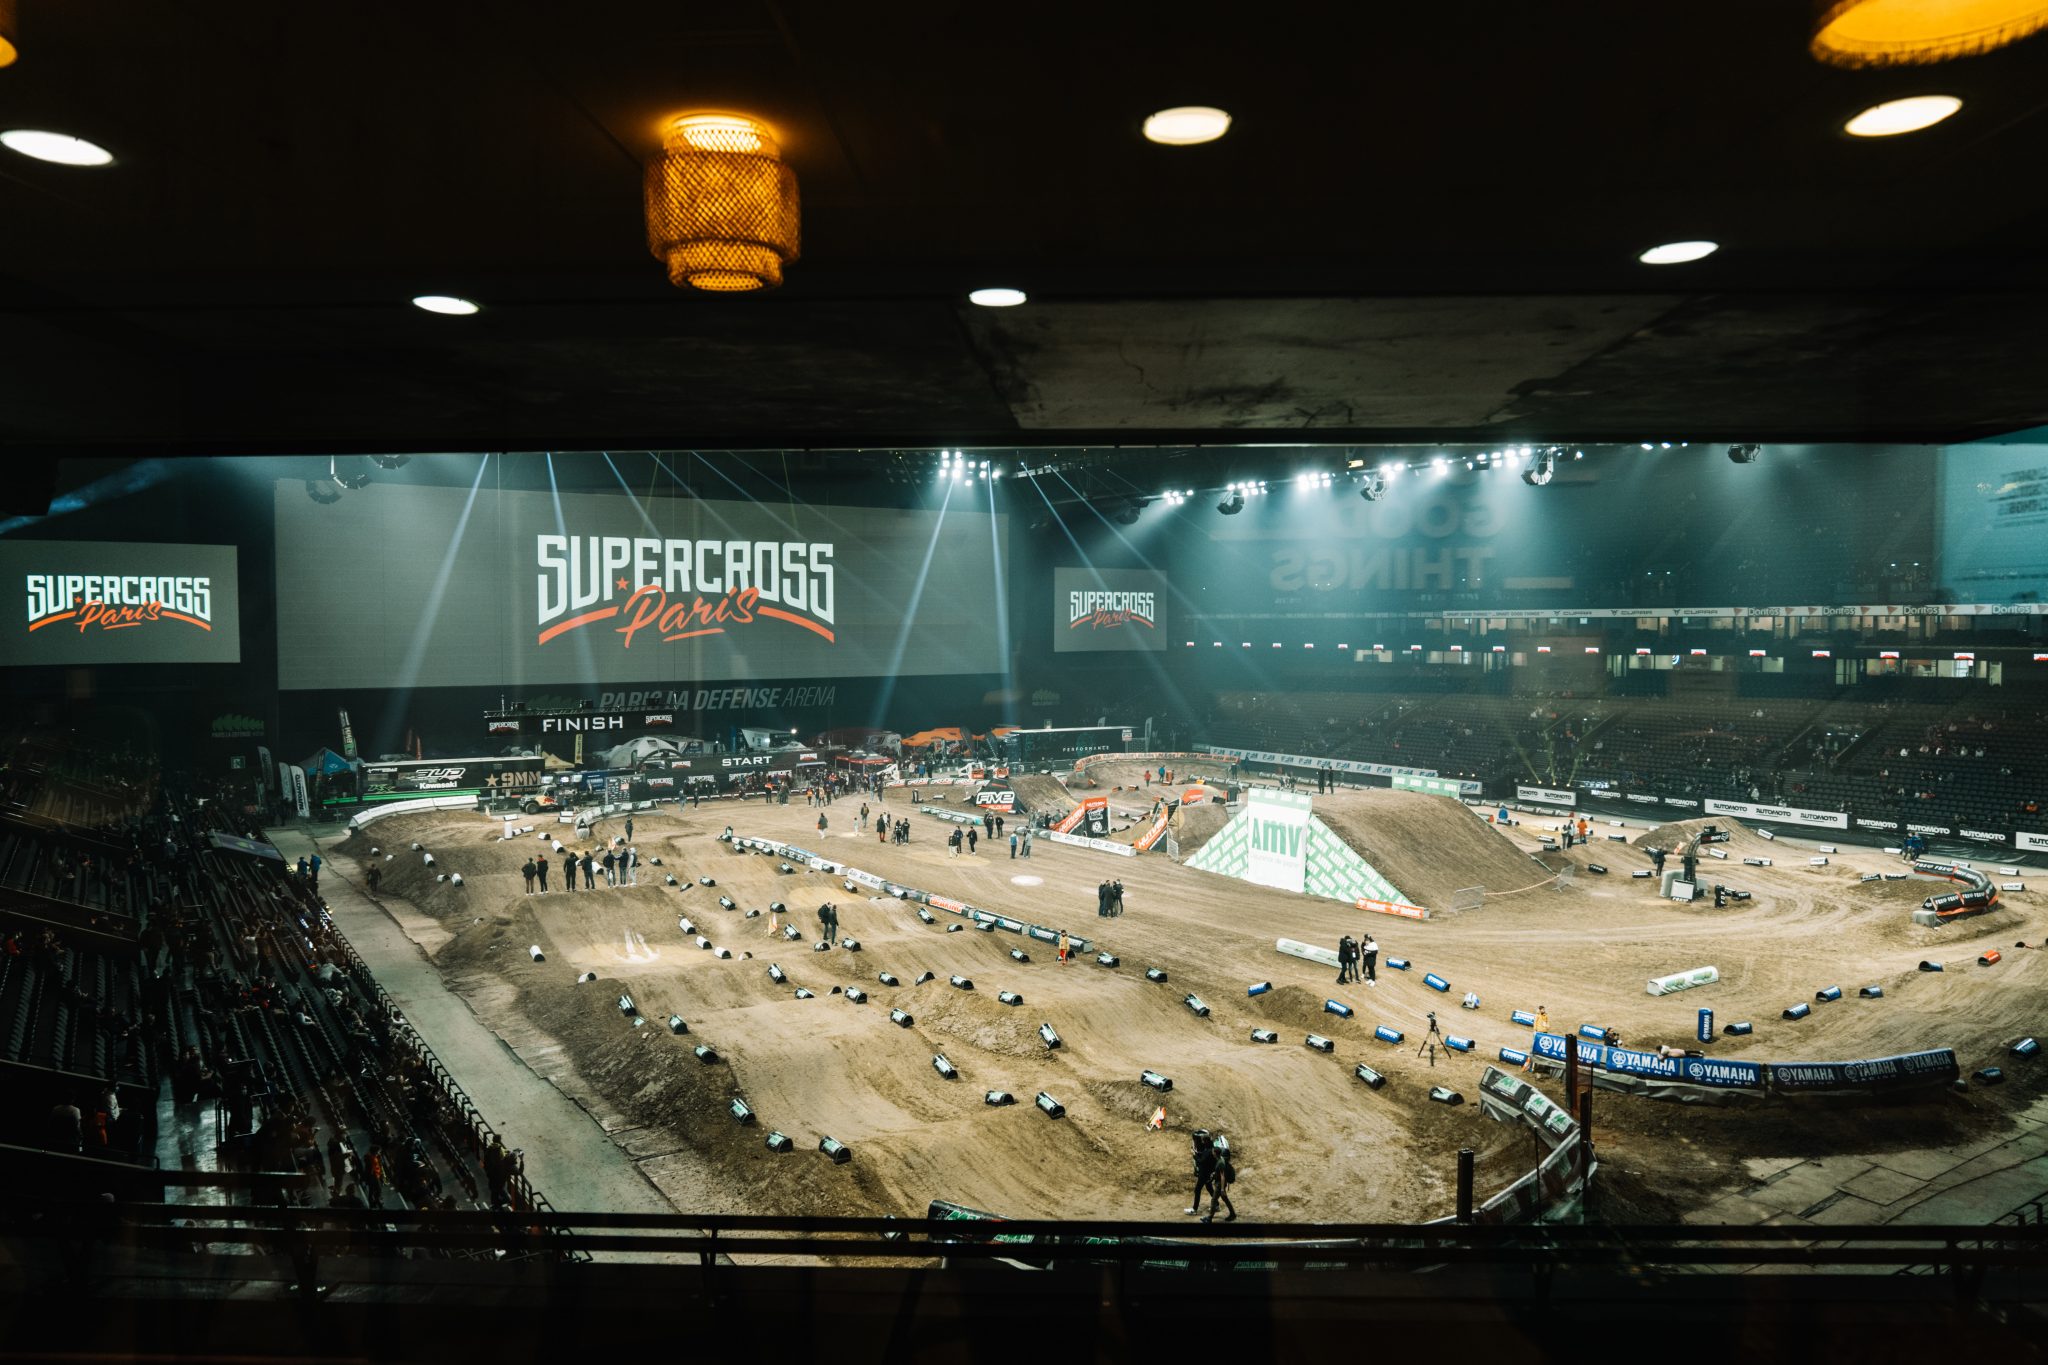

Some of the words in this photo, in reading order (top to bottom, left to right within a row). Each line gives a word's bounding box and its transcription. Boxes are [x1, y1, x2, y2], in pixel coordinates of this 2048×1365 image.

[537, 534, 834, 626] SUPERCROSS
[27, 575, 211, 622] SUPERCROSS
[1070, 591, 1154, 623] SUPERCROSS
[1749, 607, 1780, 616] Doritos
[1823, 606, 1856, 616] Doritos
[1903, 605, 1939, 615] Doritos
[1992, 604, 2031, 614] Doritos
[74, 599, 162, 633] Paris
[615, 584, 760, 649] Paris
[693, 687, 782, 711] DEFENSE
[782, 686, 836, 707] ARENA
[542, 715, 624, 732] FINISH
[722, 755, 773, 767] START
[419, 781, 457, 789] Kawasaki
[501, 771, 542, 788] 9MM
[976, 791, 1015, 804] FIVE
[1544, 792, 1572, 800] AUTOMOTO
[1591, 789, 1621, 798] AUTOMOTO
[1627, 793, 1658, 802] AUTOMOTO
[1664, 797, 1698, 807] AUTOMOTO
[1713, 803, 1747, 812] AUTOMOTO
[1755, 808, 1792, 817] AUTOMOTO
[1800, 812, 1838, 822] AUTOMOTO
[1857, 818, 1898, 829] AUTOMOTO
[1907, 824, 1951, 835] AUTOMOTO
[1960, 829, 2006, 841] AUTOMOTO
[1552, 1038, 1597, 1061] YAAHA
[1542, 1049, 1593, 1064] RACNG
[1913, 1052, 1951, 1068] YAMAHA
[1626, 1054, 1676, 1073] YAMAHA
[1856, 1061, 1898, 1078] YAMAHA
[1616, 1064, 1673, 1077] RACING
[1703, 1065, 1756, 1082] YAMAHA
[1789, 1068, 1835, 1081] YAMAHA
[1695, 1076, 1752, 1086] RACING
